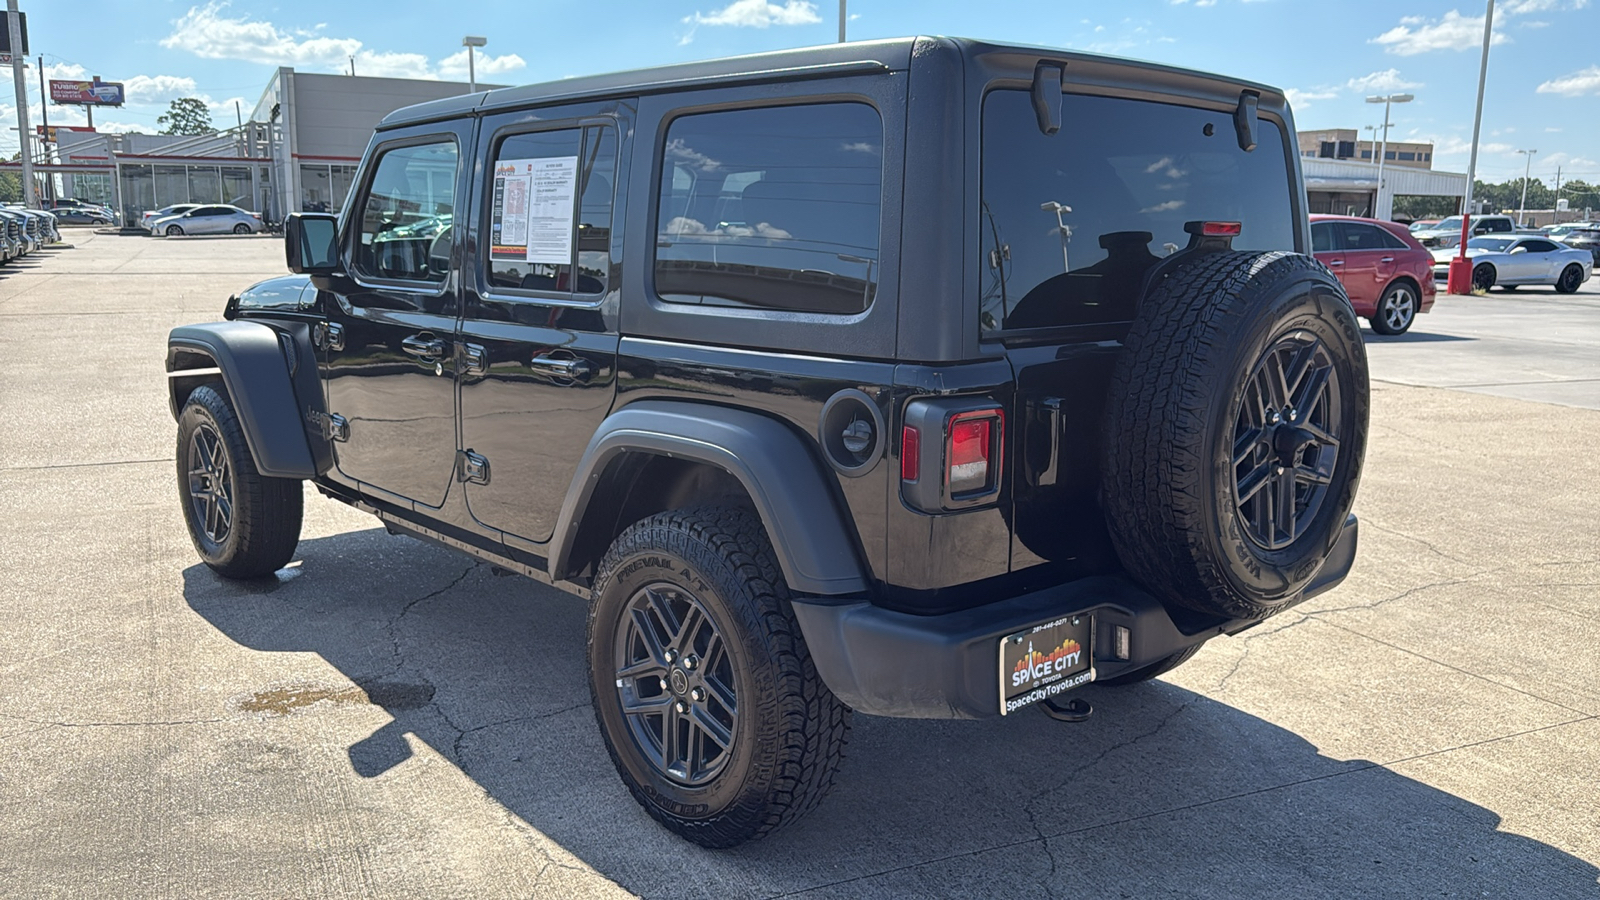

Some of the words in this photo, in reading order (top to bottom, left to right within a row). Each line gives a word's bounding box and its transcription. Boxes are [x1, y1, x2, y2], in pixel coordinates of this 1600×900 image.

[1012, 656, 1052, 687] SPACE
[1054, 650, 1081, 672] CITY
[1041, 673, 1062, 684] TOYOTA
[1006, 672, 1092, 712] SpaceCityToyota.com
